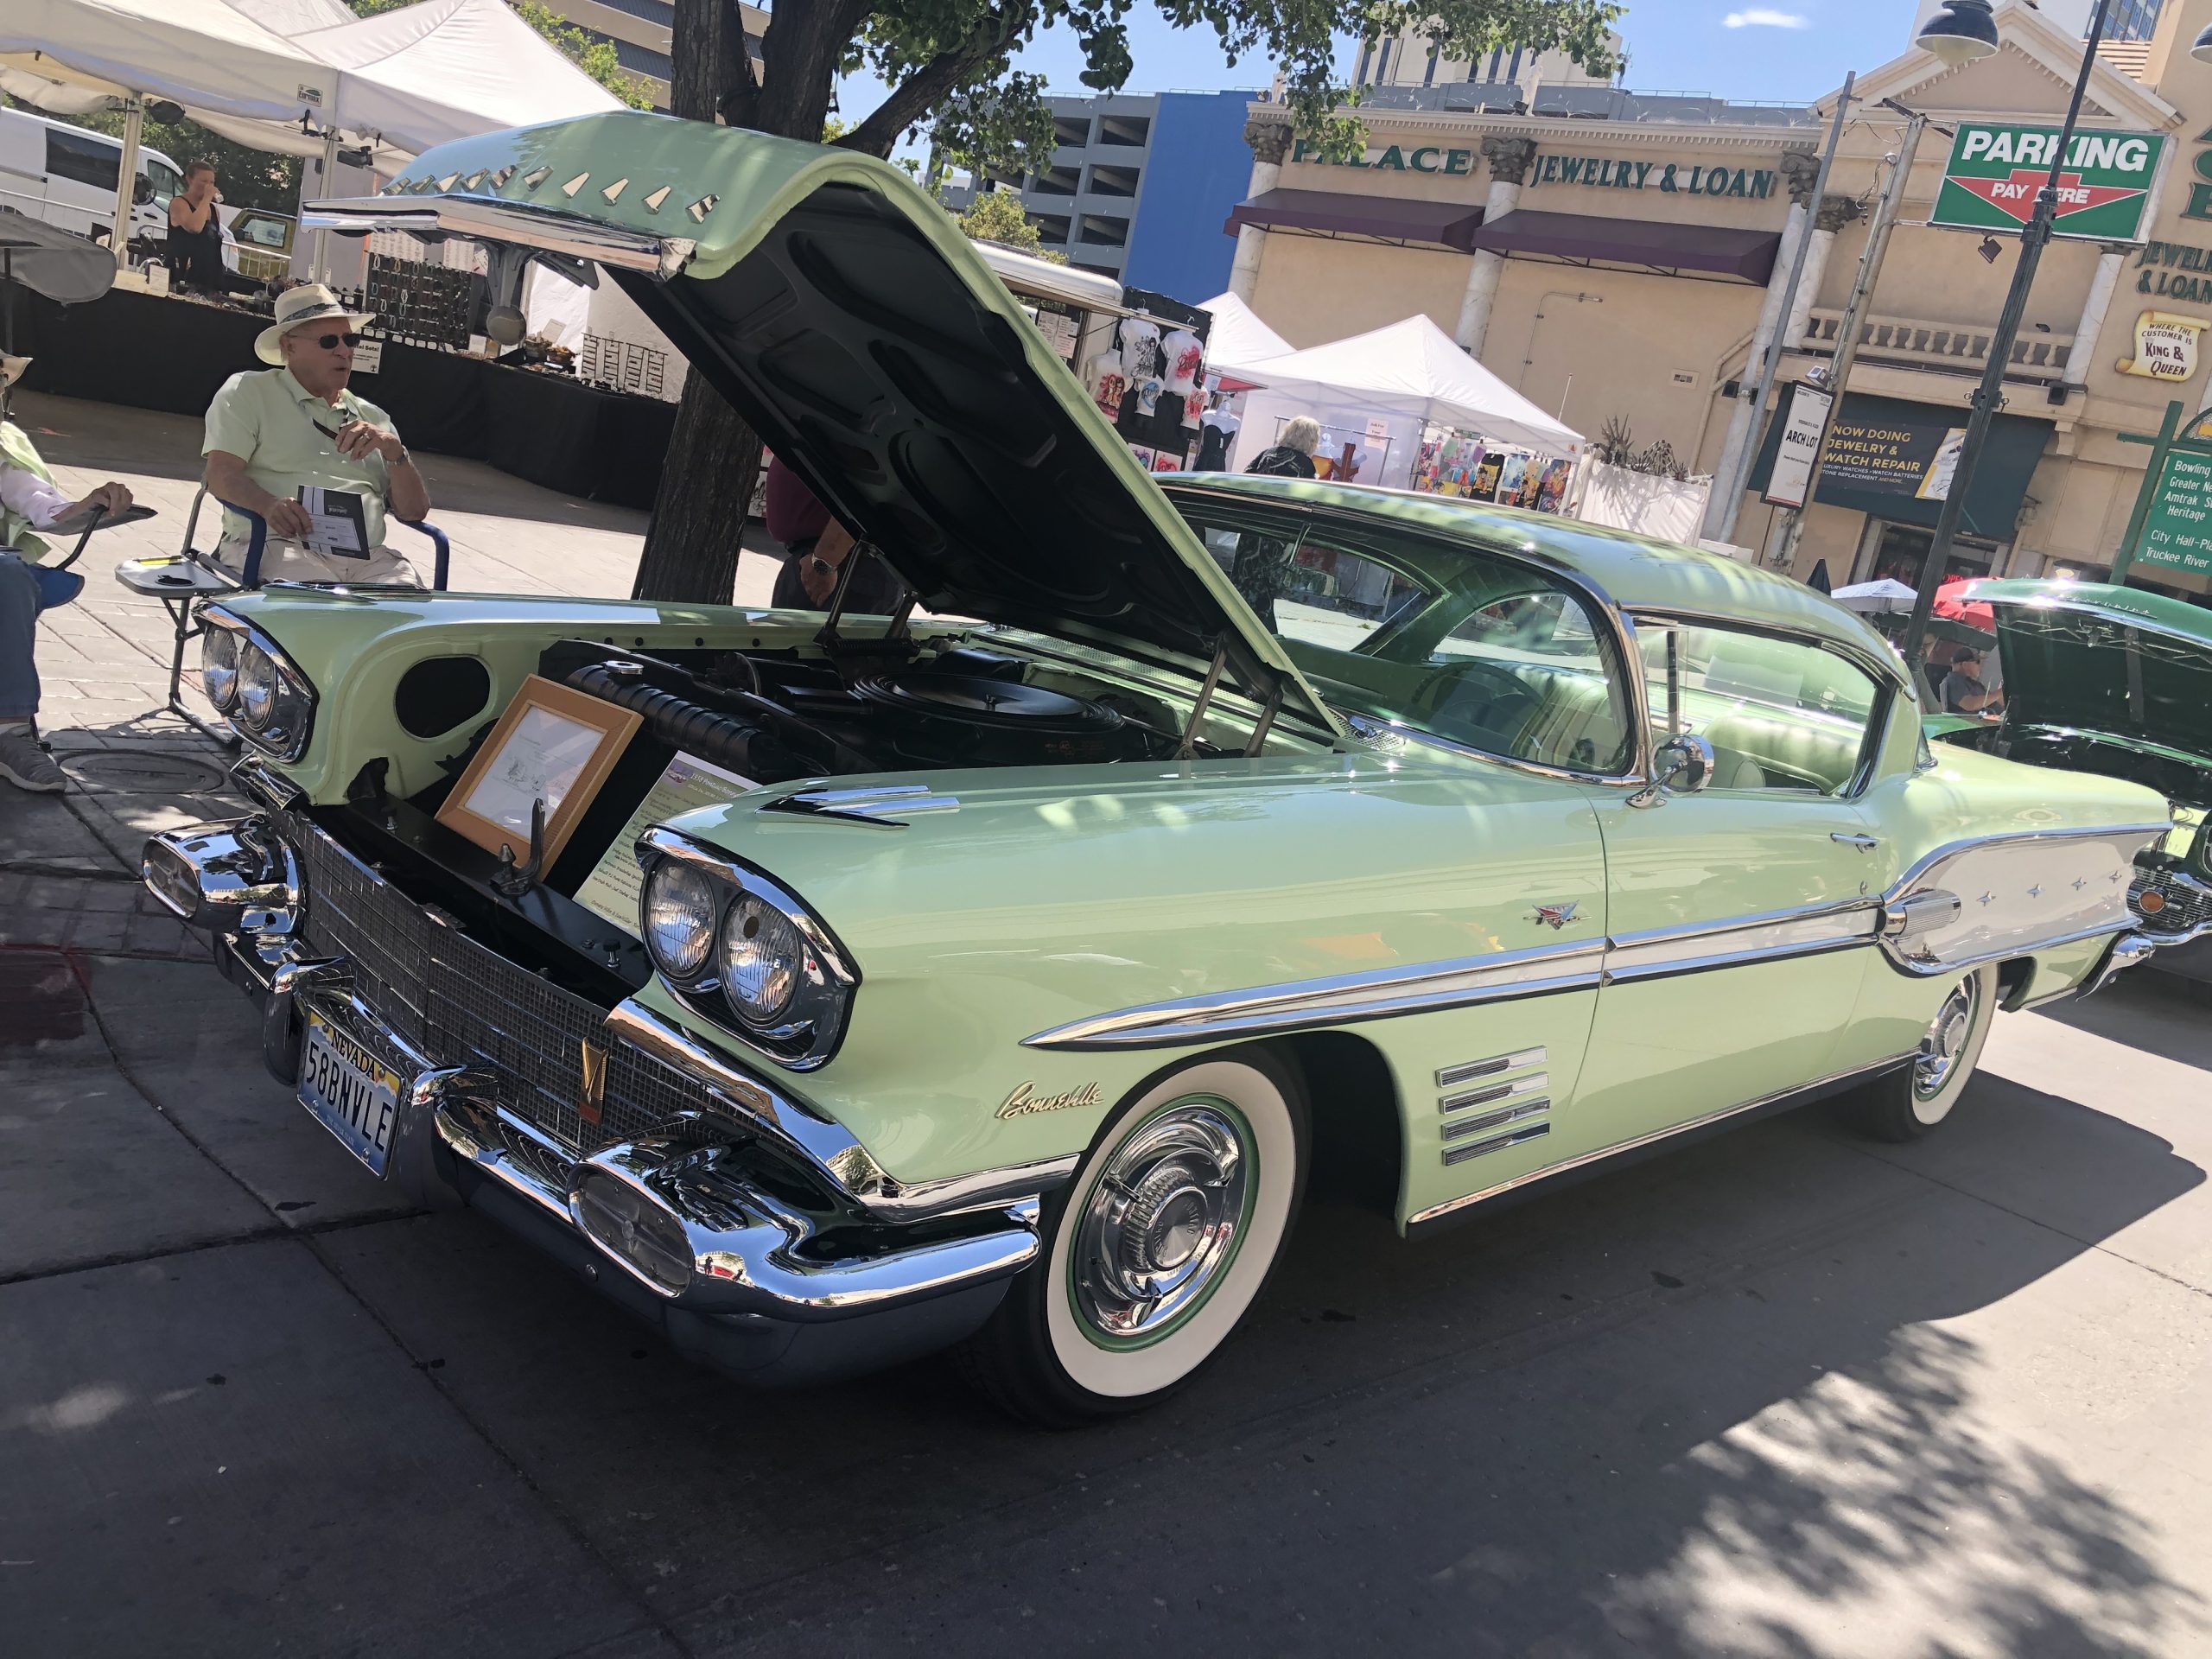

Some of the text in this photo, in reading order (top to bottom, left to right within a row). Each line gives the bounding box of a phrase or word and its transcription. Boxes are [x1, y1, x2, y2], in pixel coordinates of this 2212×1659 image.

[1291, 138, 1472, 176] PLACE
[1961, 130, 2149, 172] PARKING
[1529, 155, 1775, 200] JEWELRY & LOAN
[1991, 182, 2091, 204] PAY ERE
[2137, 270, 2152, 293] &
[2141, 330, 2193, 346] CUSTOMER IS
[2149, 323, 2192, 337] WHERE THE
[2173, 346, 2184, 362] &
[1785, 429, 1819, 449] ARCH LOT
[1833, 424, 1865, 438] NOW
[1866, 428, 1911, 443] DOING
[1827, 438, 1898, 456] JEWELRY &
[1824, 452, 1870, 467] WATCH
[1872, 458, 1921, 473] REPAIR
[2174, 460, 2211, 479] Bowling
[1837, 471, 1878, 481] REPLACEMENT
[2169, 476, 2200, 491] Greater
[2164, 491, 2198, 506] Amtrak
[2167, 505, 2206, 523] Heritage
[2151, 529, 2171, 545] City
[2145, 546, 2210, 569] Truckee River
[330, 1027, 375, 1081] NEVADA
[307, 1041, 392, 1152] 58BNVLE
[995, 1080, 1105, 1120] Bonneville
